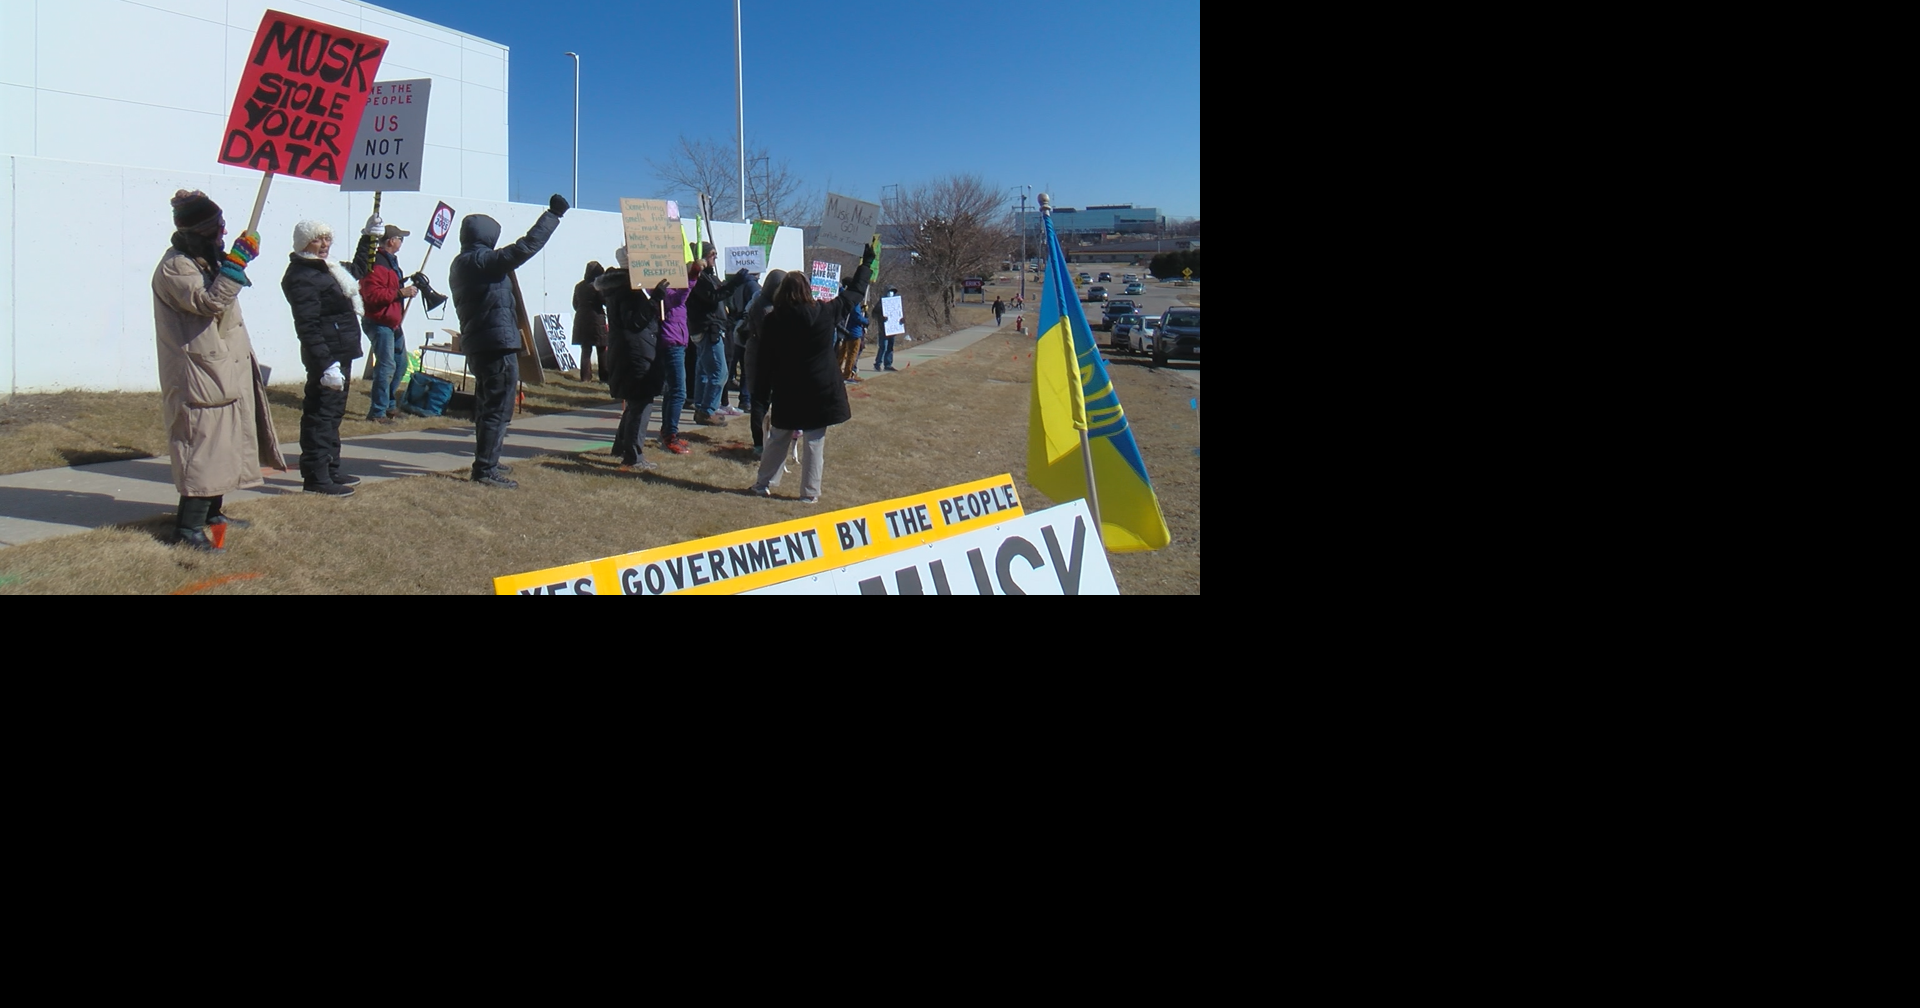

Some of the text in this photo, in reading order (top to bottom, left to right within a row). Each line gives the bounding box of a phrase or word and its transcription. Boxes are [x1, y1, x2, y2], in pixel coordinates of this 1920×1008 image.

[253, 20, 381, 92] MUSK
[252, 72, 350, 120] STOLE
[391, 84, 412, 93] THE
[244, 98, 341, 156] YOUR
[365, 138, 403, 156] NOT
[374, 115, 398, 132] US
[222, 129, 339, 181] DATA
[354, 162, 409, 180] MUSK
[621, 528, 819, 595] GOVERNMENT
[835, 517, 870, 551] BY
[885, 504, 933, 538] THE
[939, 484, 1018, 525] PEOPLE
